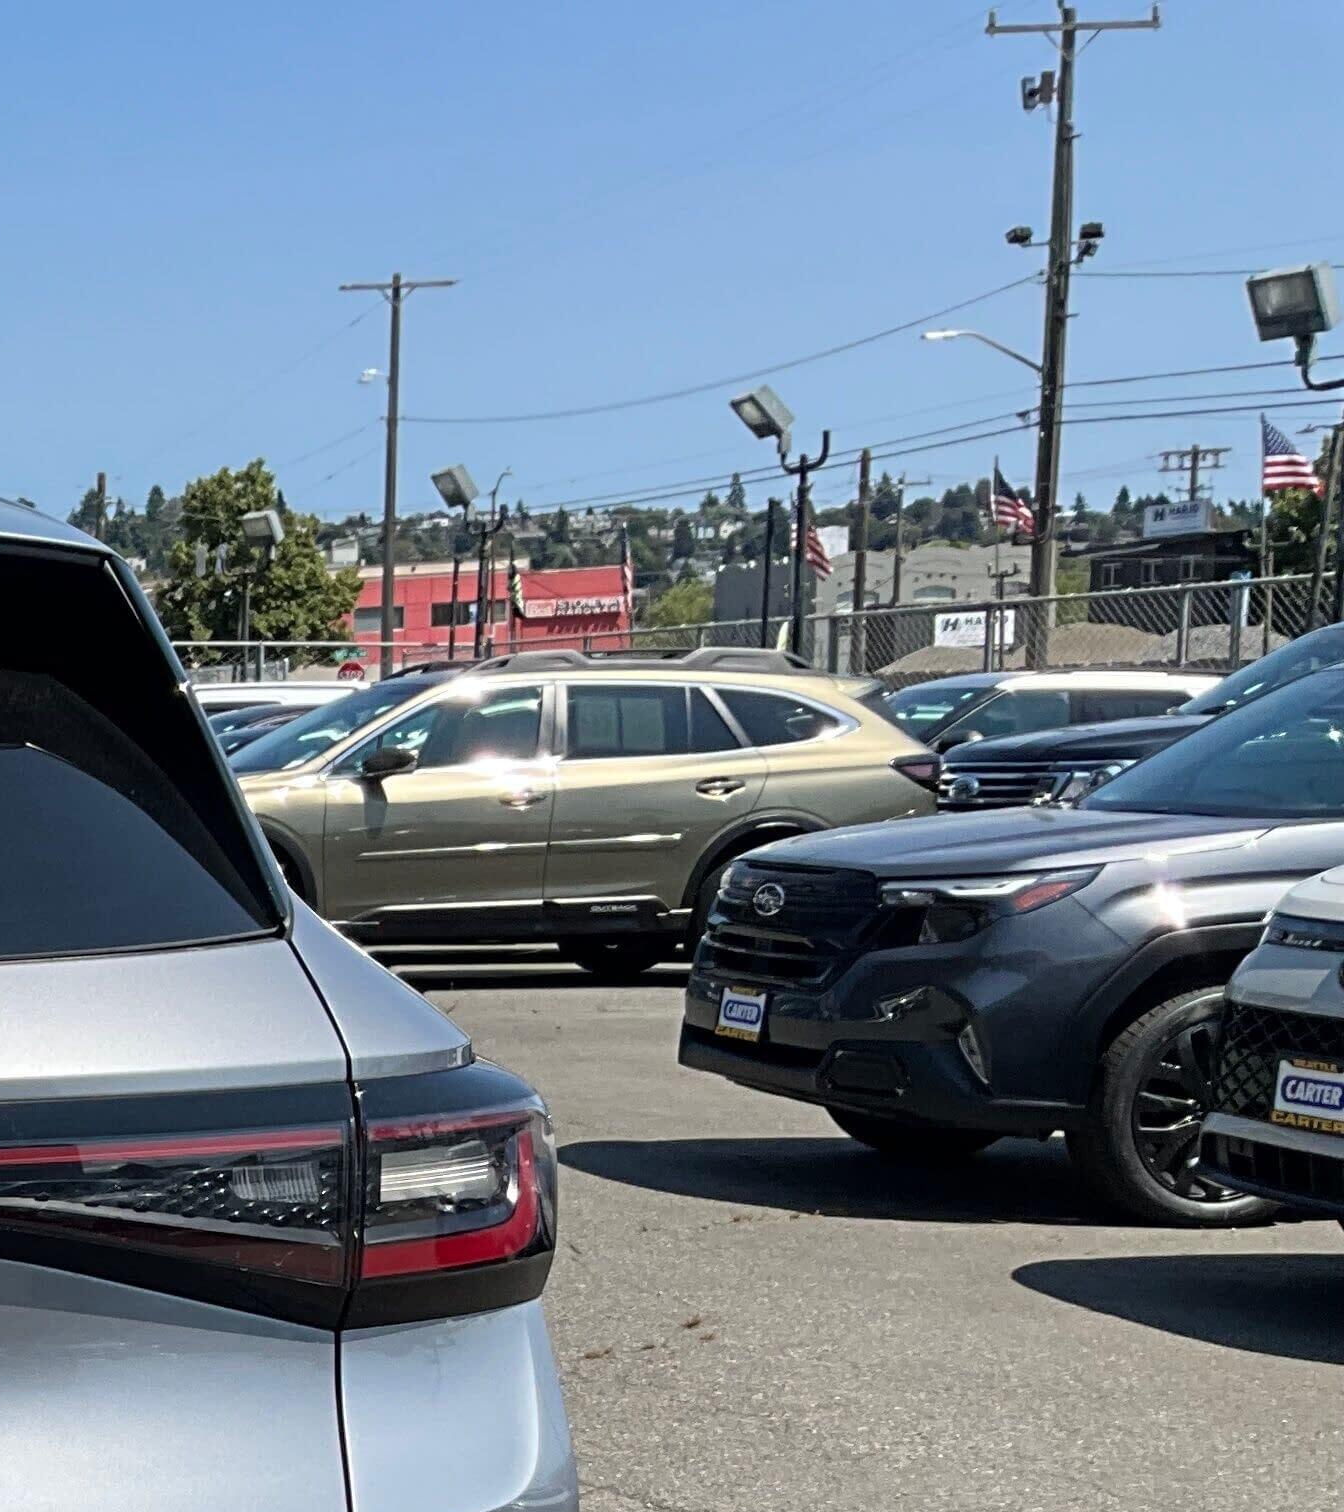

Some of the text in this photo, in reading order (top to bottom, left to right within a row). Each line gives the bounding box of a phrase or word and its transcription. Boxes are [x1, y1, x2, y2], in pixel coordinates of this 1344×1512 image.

[727, 1002, 759, 1022] CARTER
[1285, 1079, 1343, 1107] CARTER
[1271, 1111, 1344, 1135] CARTER
